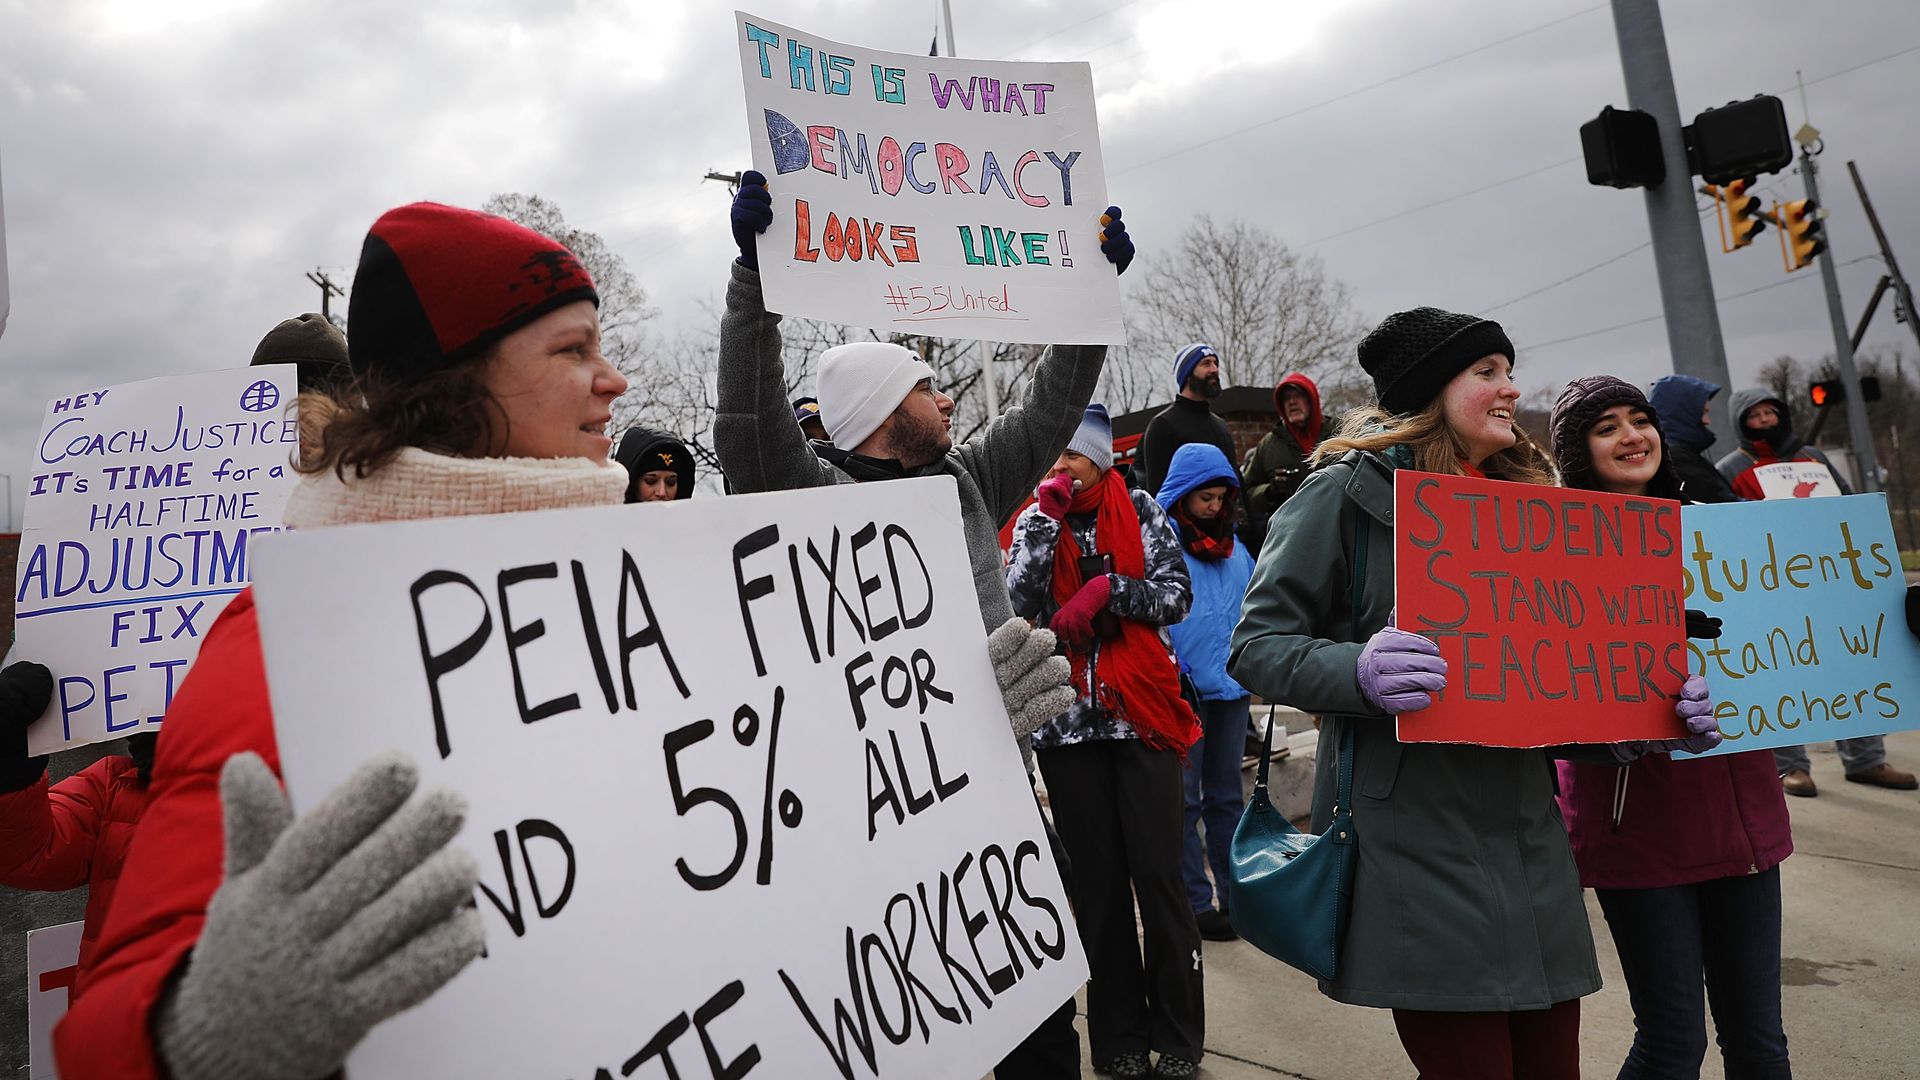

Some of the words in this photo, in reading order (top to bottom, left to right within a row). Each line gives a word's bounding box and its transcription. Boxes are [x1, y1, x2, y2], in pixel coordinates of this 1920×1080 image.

[744, 22, 856, 96] THIS
[871, 63, 906, 105] IS
[928, 73, 1055, 116] WHAT
[763, 108, 1082, 208] DEMOCRACY
[793, 198, 920, 267] LOOKS
[956, 224, 1074, 268] LIKE!
[883, 284, 1019, 315] #55United
[40, 417, 148, 464] COACH
[150, 406, 298, 453] JUSTICE
[53, 389, 110, 414] HEY
[90, 492, 260, 532] HALFTIME
[102, 462, 193, 491] TIME
[212, 458, 260, 482] for
[268, 464, 284, 479] a
[1408, 478, 1675, 557] STUDENTS
[17, 526, 296, 602] ADJUSTM
[1416, 550, 1586, 630] STAND
[1599, 584, 1681, 627] WITH
[111, 601, 204, 647] FIX
[408, 548, 691, 760] PEIA
[732, 521, 934, 677] FIXED
[1838, 613, 1885, 659] w/
[59, 659, 188, 741] PEI
[845, 647, 955, 731] FOR
[1714, 682, 1900, 741] eachers
[865, 721, 970, 842] ALL
[461, 818, 577, 958] ND
[662, 686, 803, 891] 5%
[777, 839, 1066, 1080] WORKERS
